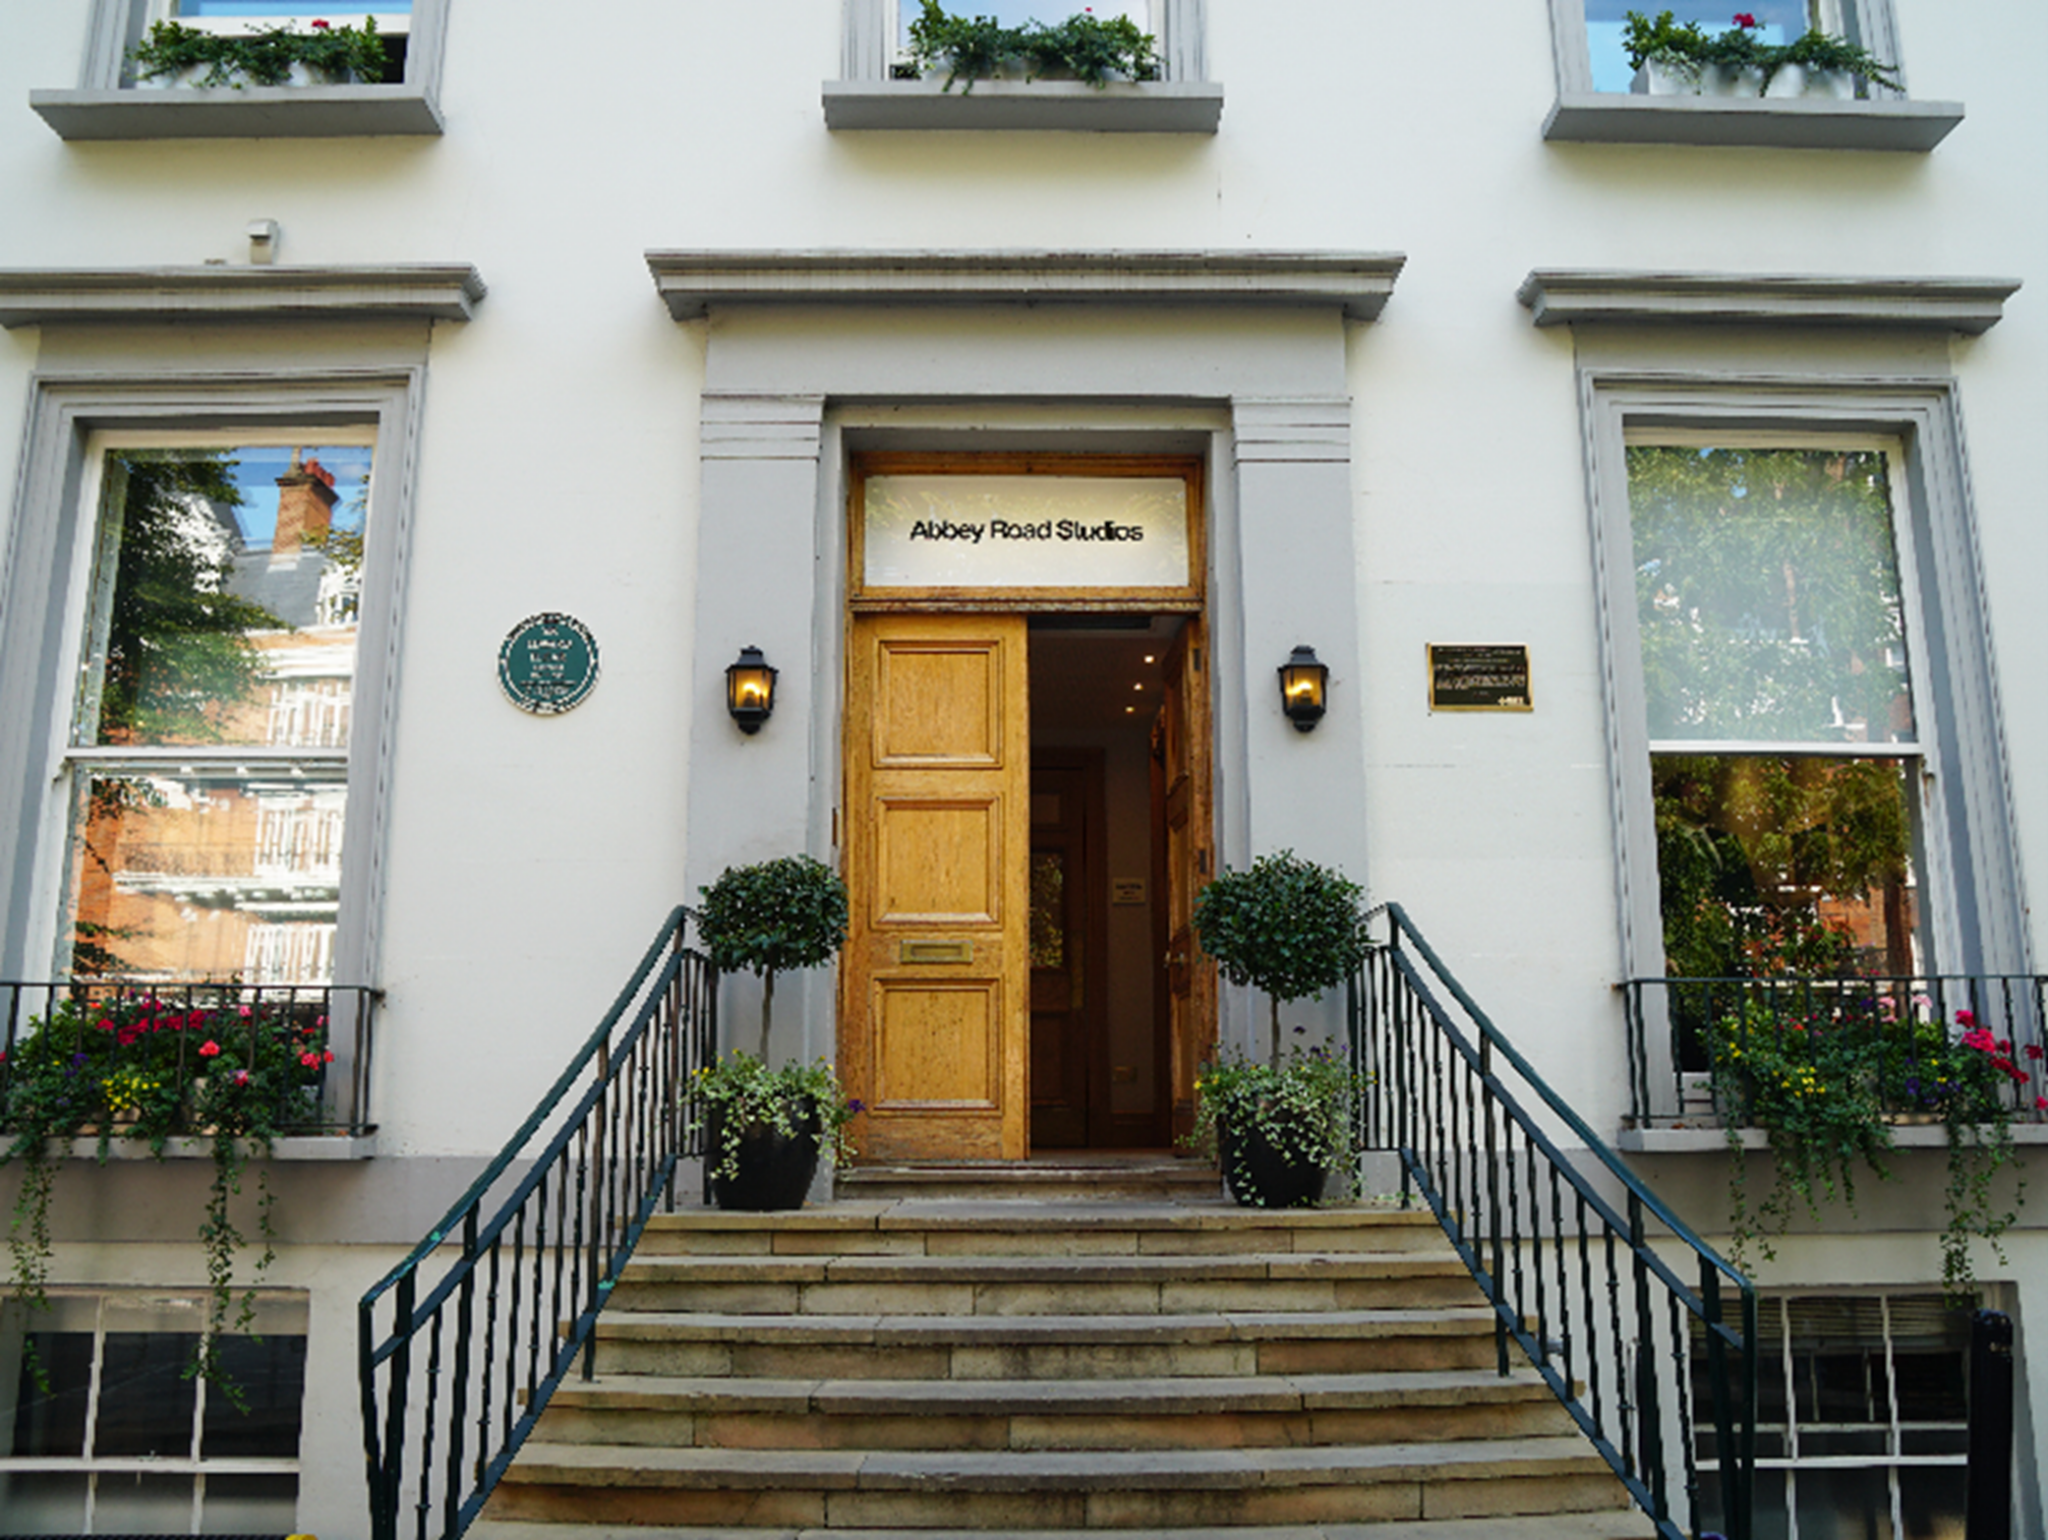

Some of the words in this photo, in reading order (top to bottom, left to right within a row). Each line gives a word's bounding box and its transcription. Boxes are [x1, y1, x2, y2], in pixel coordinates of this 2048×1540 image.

[911, 520, 984, 543] Abbey
[991, 520, 1051, 540] Road
[1056, 519, 1143, 541] Studios
